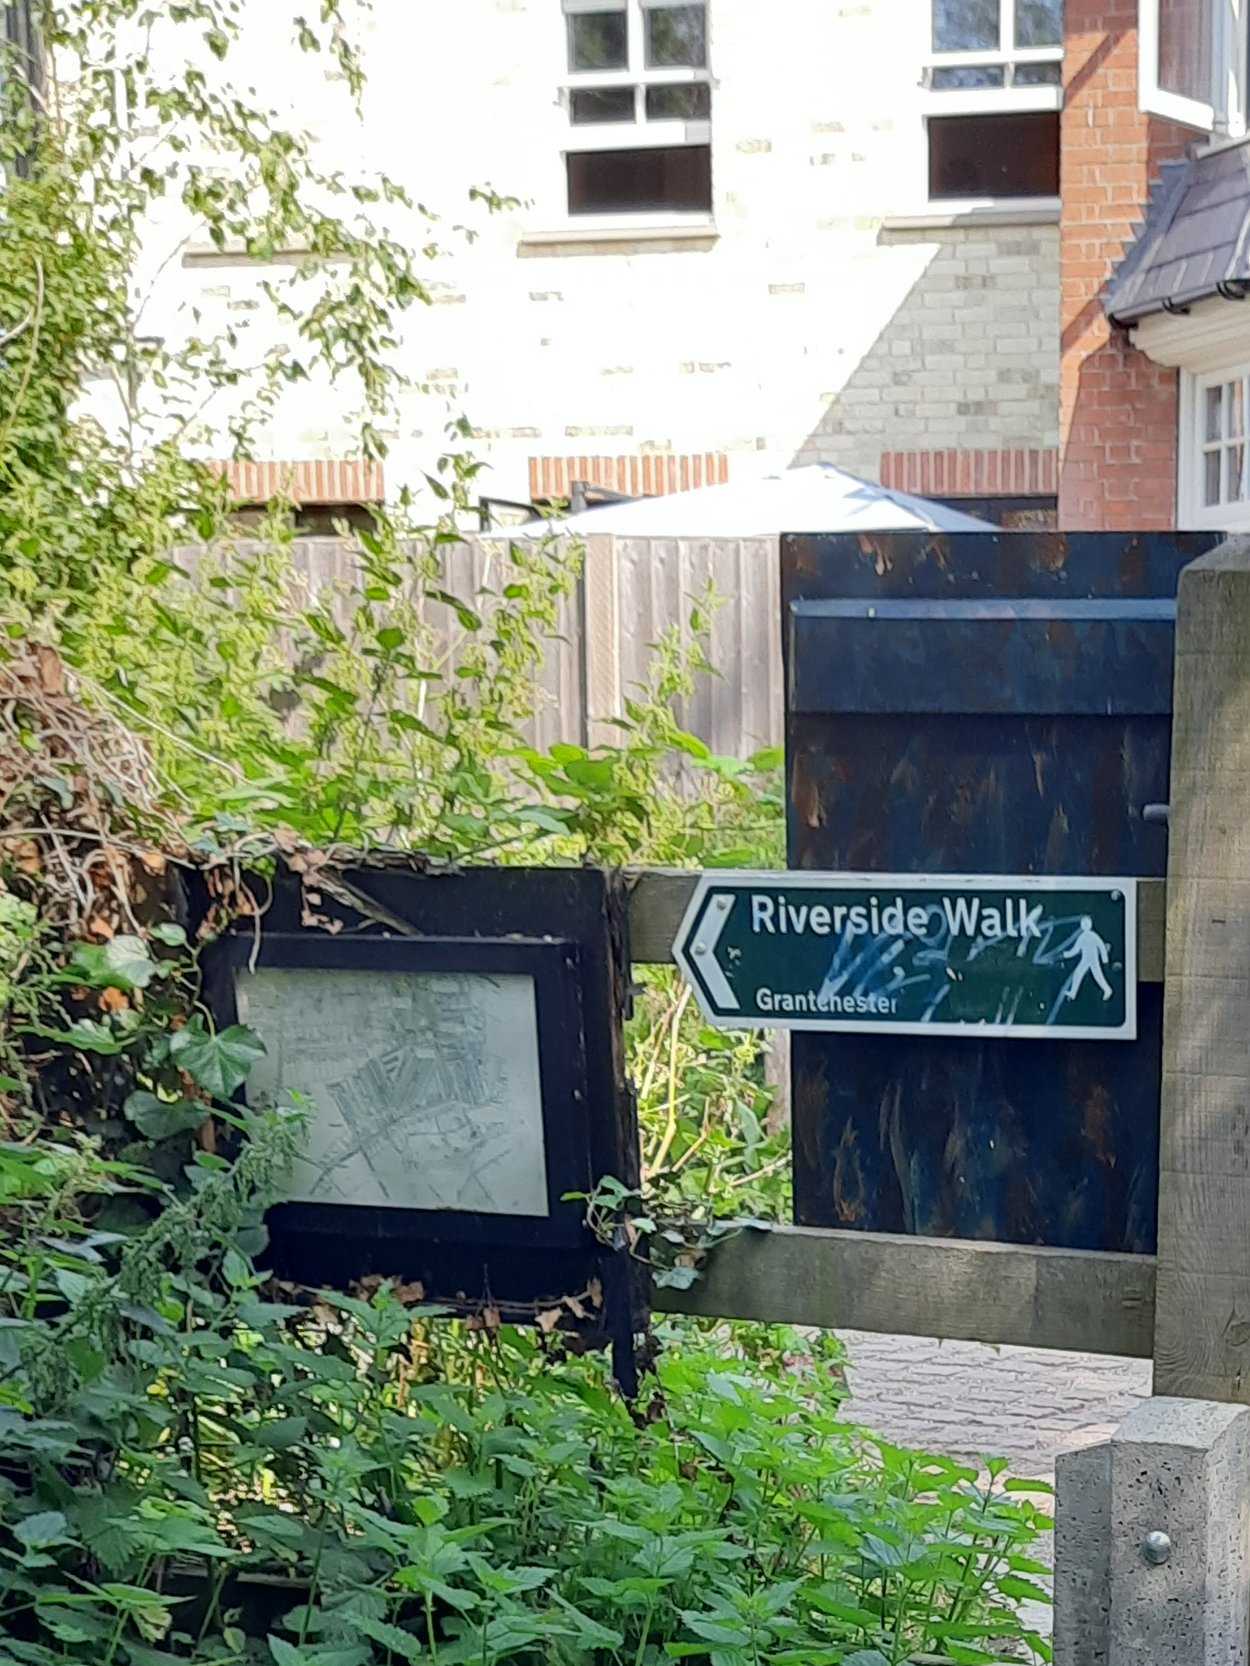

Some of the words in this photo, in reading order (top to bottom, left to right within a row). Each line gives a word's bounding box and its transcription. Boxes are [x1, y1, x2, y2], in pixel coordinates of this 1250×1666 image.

[751, 894, 929, 936] Riverside
[942, 896, 1043, 938] Walk
[755, 987, 897, 1014] Grantchester
